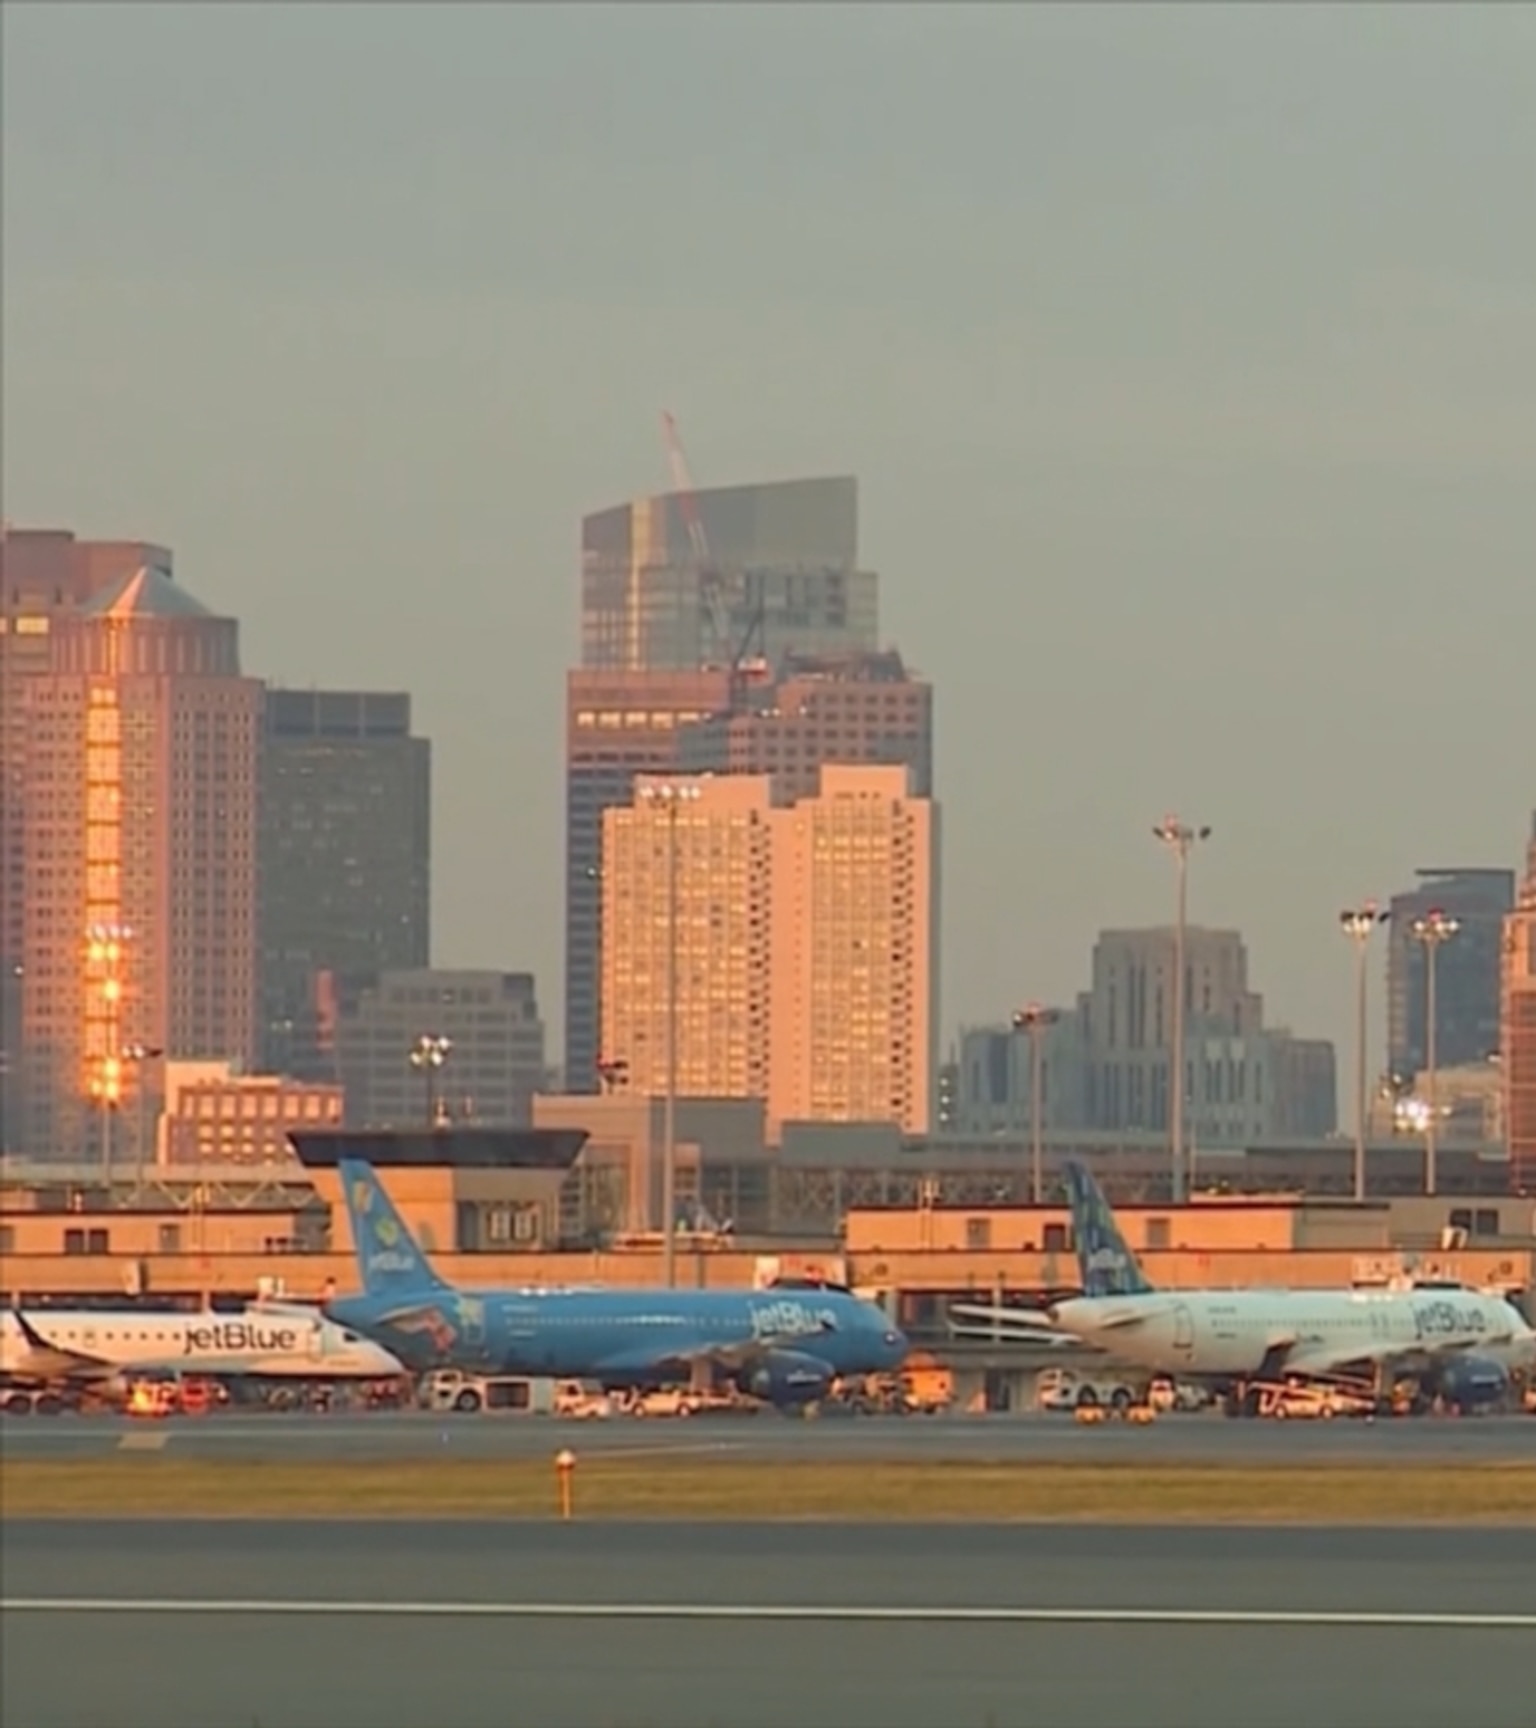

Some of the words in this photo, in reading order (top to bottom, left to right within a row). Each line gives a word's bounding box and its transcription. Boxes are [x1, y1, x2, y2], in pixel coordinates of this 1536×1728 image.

[184, 1322, 297, 1354] jetBlue
[747, 1300, 837, 1338] jetBlue
[1409, 1301, 1486, 1340] jetBlue
